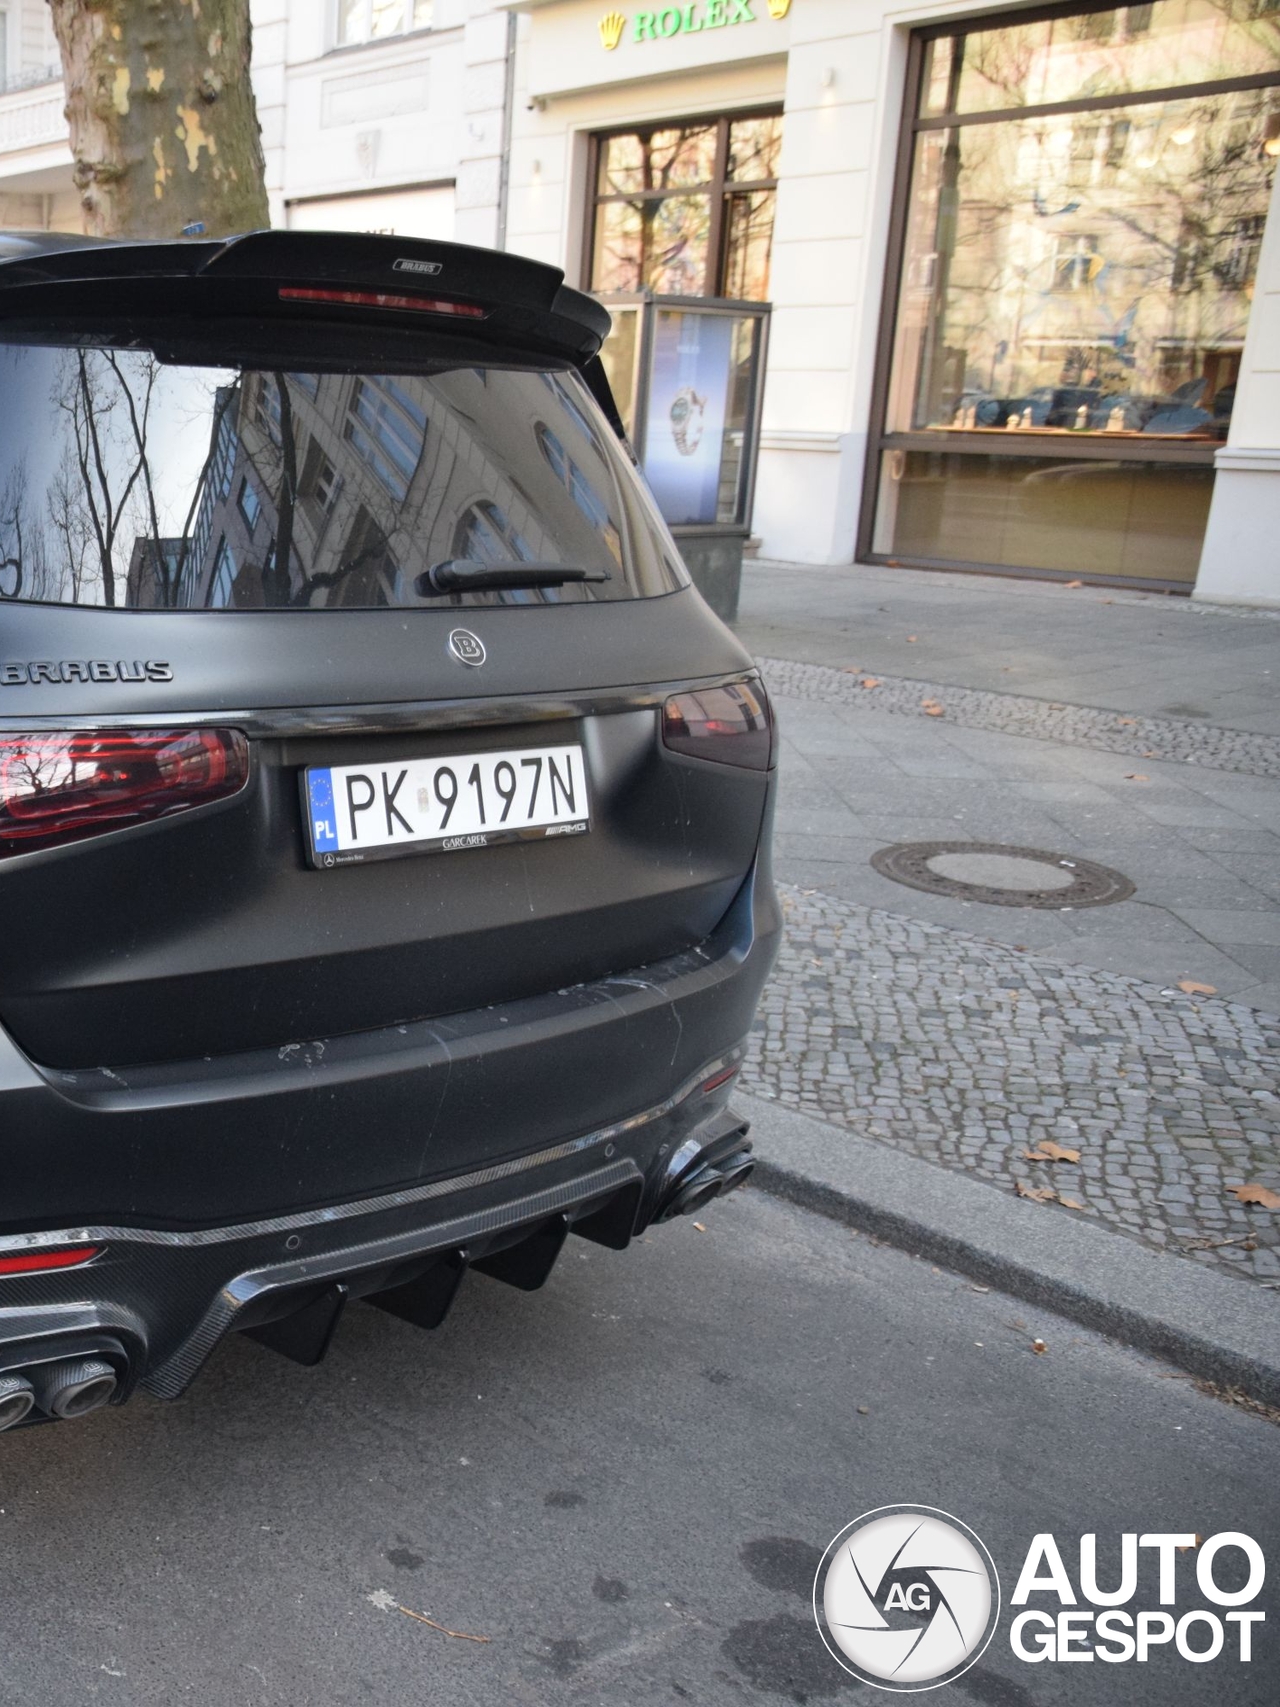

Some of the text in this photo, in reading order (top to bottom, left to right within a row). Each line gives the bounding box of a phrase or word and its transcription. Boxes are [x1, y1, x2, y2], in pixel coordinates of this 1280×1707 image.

[632, 0, 757, 42] ROLEX
[400, 261, 436, 273] BRABUS
[345, 755, 577, 841] PK 9197N
[314, 820, 335, 840] PL
